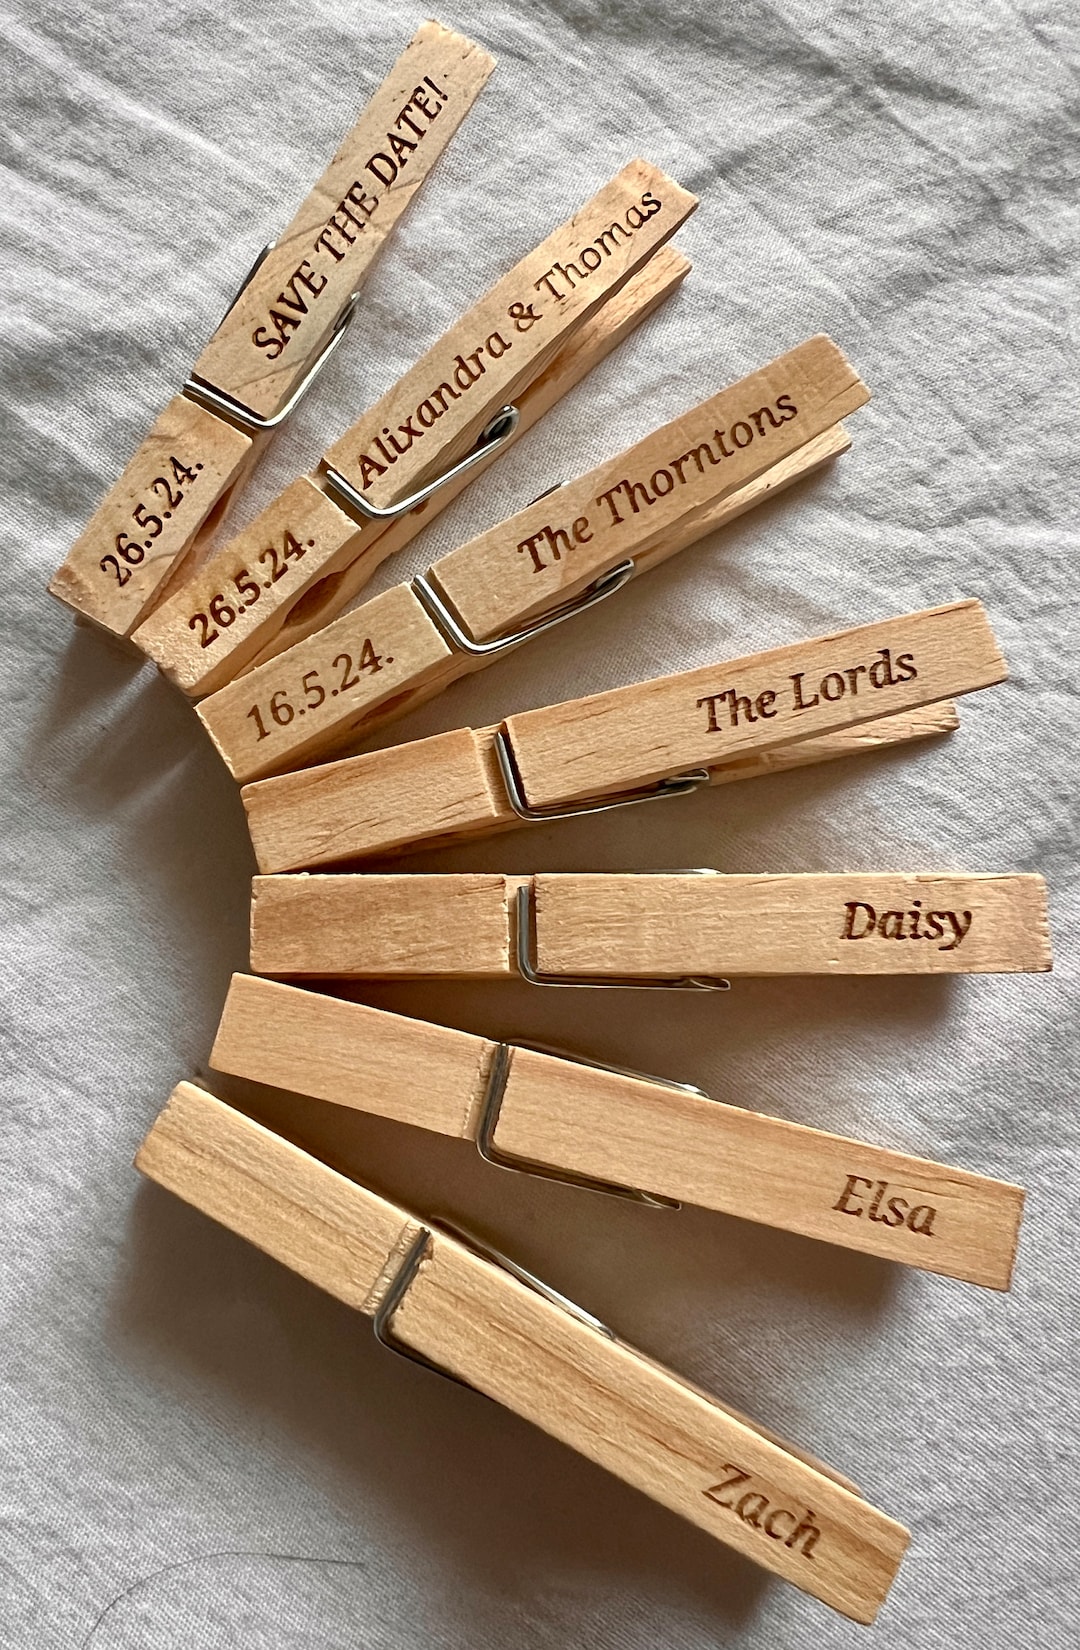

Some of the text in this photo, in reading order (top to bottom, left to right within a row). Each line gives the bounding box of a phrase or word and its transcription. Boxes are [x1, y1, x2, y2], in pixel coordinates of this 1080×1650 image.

[251, 76, 449, 360] SAVE THE DATE!
[357, 191, 662, 490] Alixandra & Thomas
[100, 456, 204, 587] 26.5.24.
[517, 393, 799, 574] The Thorntons
[188, 529, 315, 649] 26.5.24.
[246, 638, 394, 741] 16.5.24.
[697, 648, 918, 733] The Lords
[839, 901, 972, 951] Daisy
[832, 1174, 937, 1237] Elsa
[701, 1463, 821, 1559] Zach
